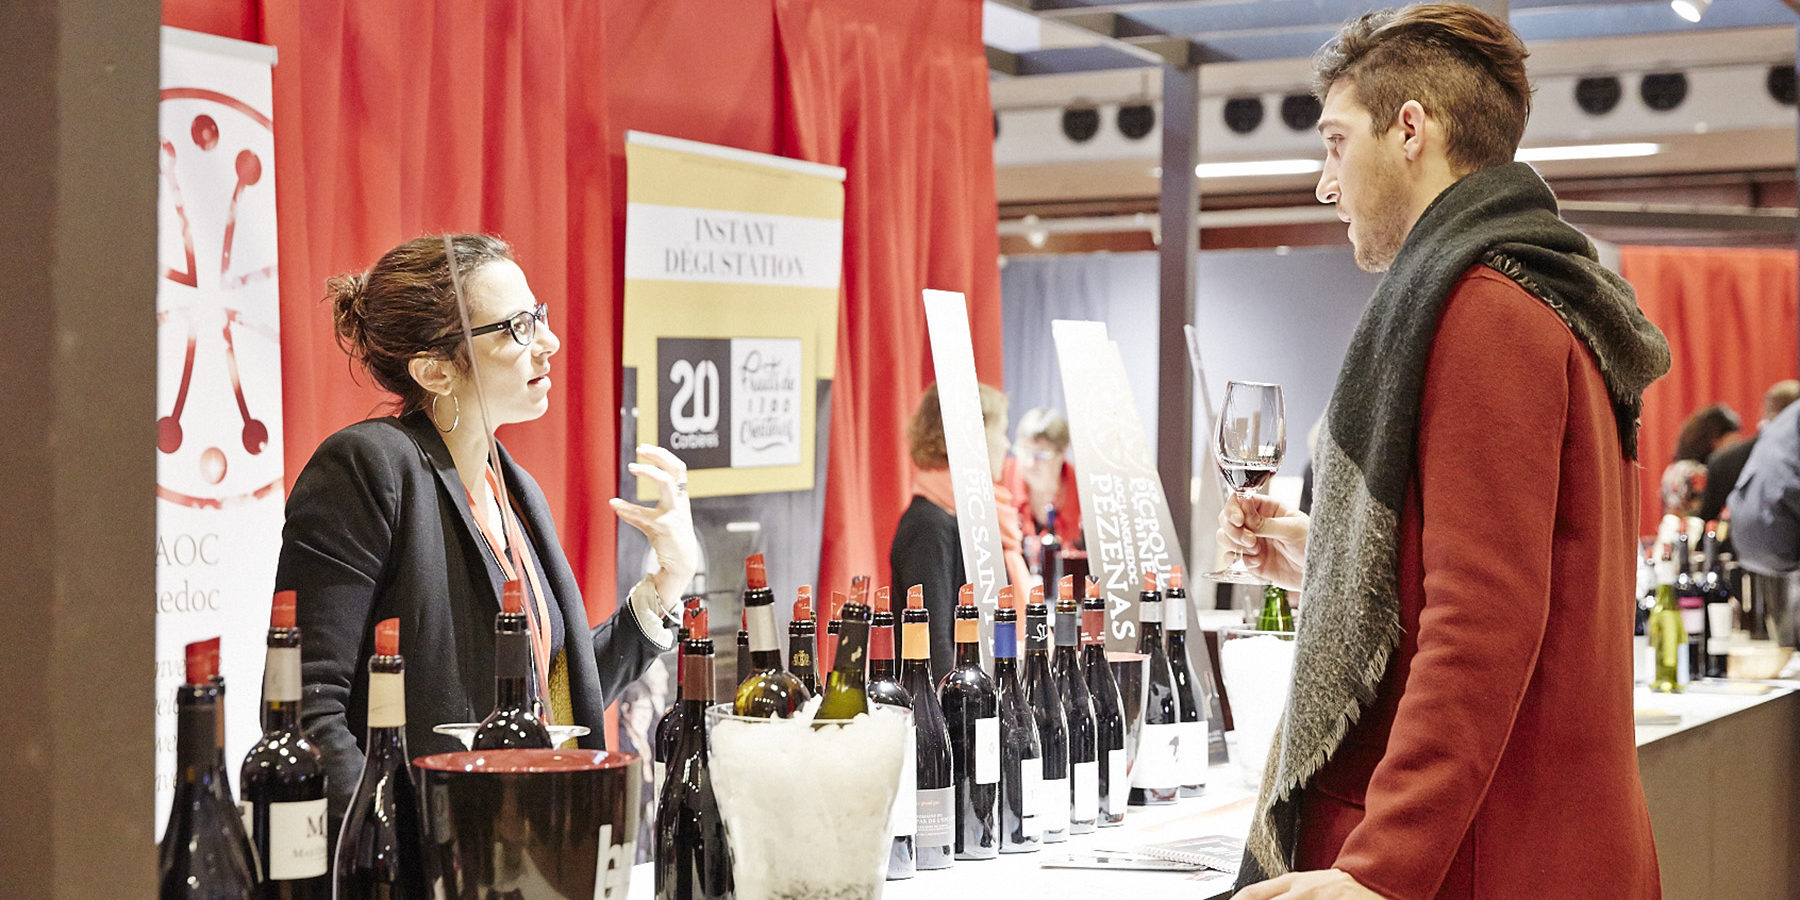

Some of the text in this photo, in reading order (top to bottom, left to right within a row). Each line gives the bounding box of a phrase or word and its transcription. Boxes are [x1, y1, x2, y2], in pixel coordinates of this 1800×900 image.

[694, 217, 777, 246] INSTANT
[664, 243, 804, 278] DÉGUSTATION
[670, 359, 720, 434] 20
[962, 467, 987, 520] PIC
[155, 533, 219, 567] AOC
[156, 579, 221, 614] edoc
